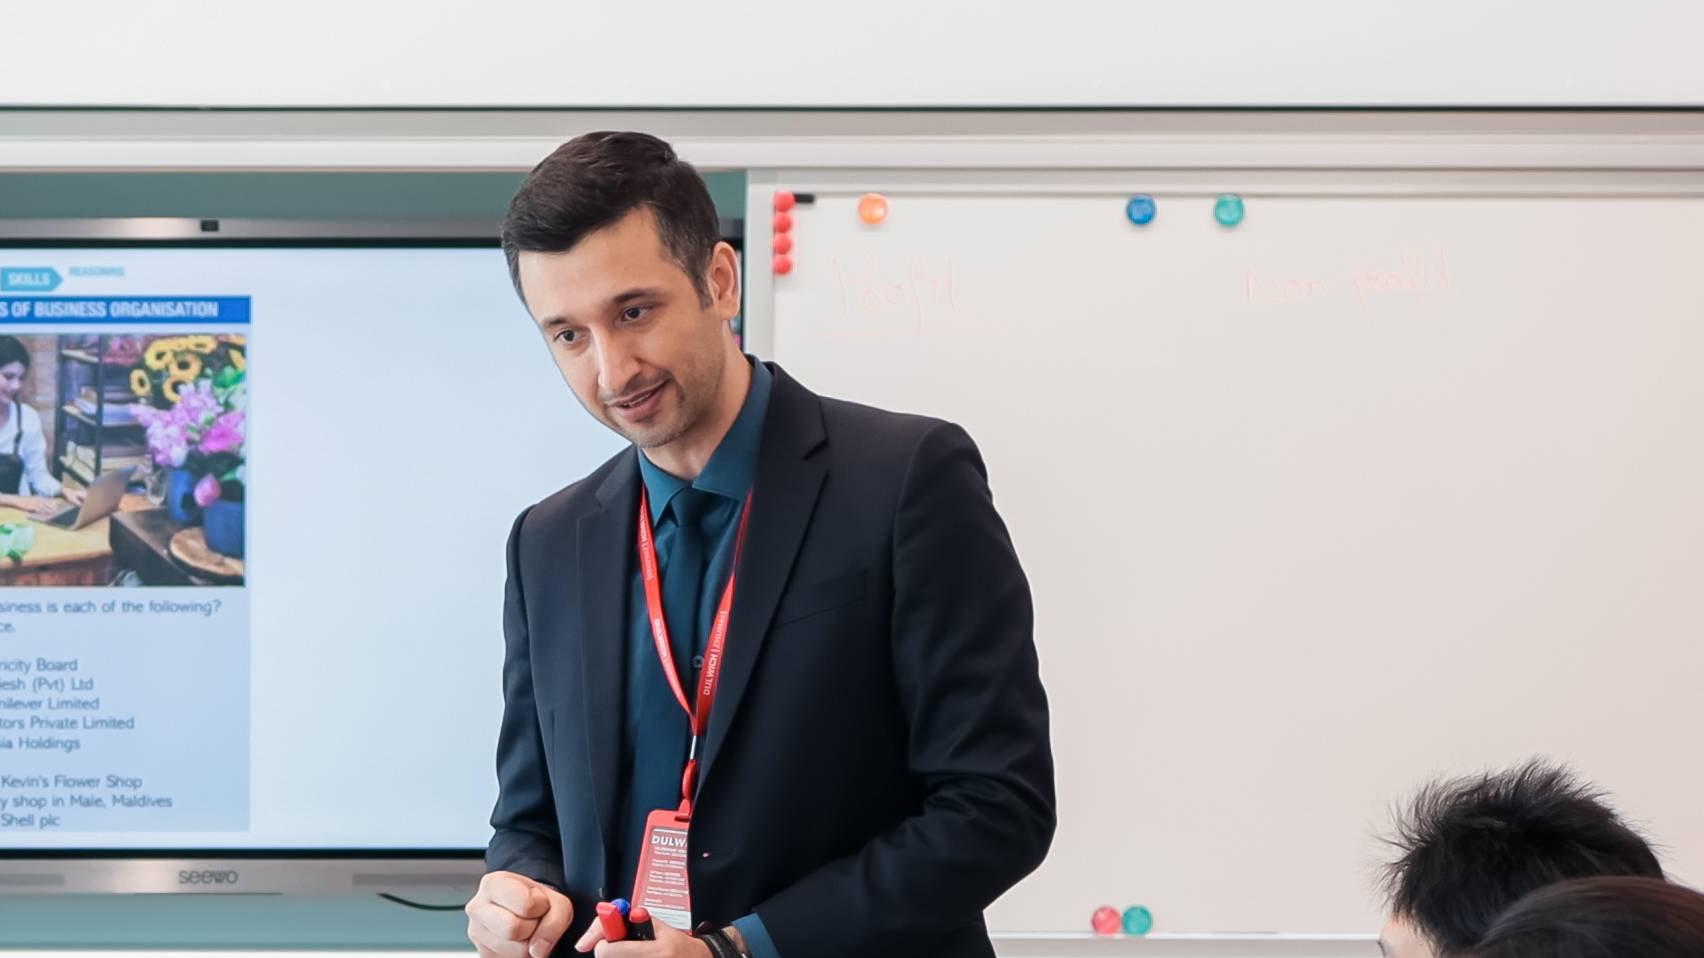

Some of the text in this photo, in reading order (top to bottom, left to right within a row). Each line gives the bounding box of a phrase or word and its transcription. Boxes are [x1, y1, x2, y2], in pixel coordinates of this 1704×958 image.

[7, 272, 50, 286] SKILLS
[11, 302, 31, 317] OF
[35, 302, 106, 317] BUSINESS
[110, 302, 219, 317] ORGANISATION
[46, 601, 59, 613] is
[62, 600, 97, 613] each
[100, 599, 117, 613] of
[121, 600, 145, 613] the
[148, 599, 223, 616] following?
[35, 656, 79, 672] Board
[703, 653, 719, 696] DULWICH
[31, 676, 66, 693] (Pvt)
[70, 676, 94, 691] Ltd
[47, 696, 100, 710] Limited
[29, 715, 79, 729] Private
[82, 716, 136, 729] Limited
[18, 735, 81, 752] Holdings
[0, 775, 50, 788] Kevin's
[53, 773, 101, 788] Flower
[105, 773, 143, 790] Shop
[12, 794, 48, 810] shop
[51, 795, 65, 807] in
[111, 793, 173, 808] Maldives
[0, 812, 36, 827] Shell
[38, 813, 61, 830] plc
[651, 835, 688, 847] DULW
[178, 870, 239, 884] seewo
